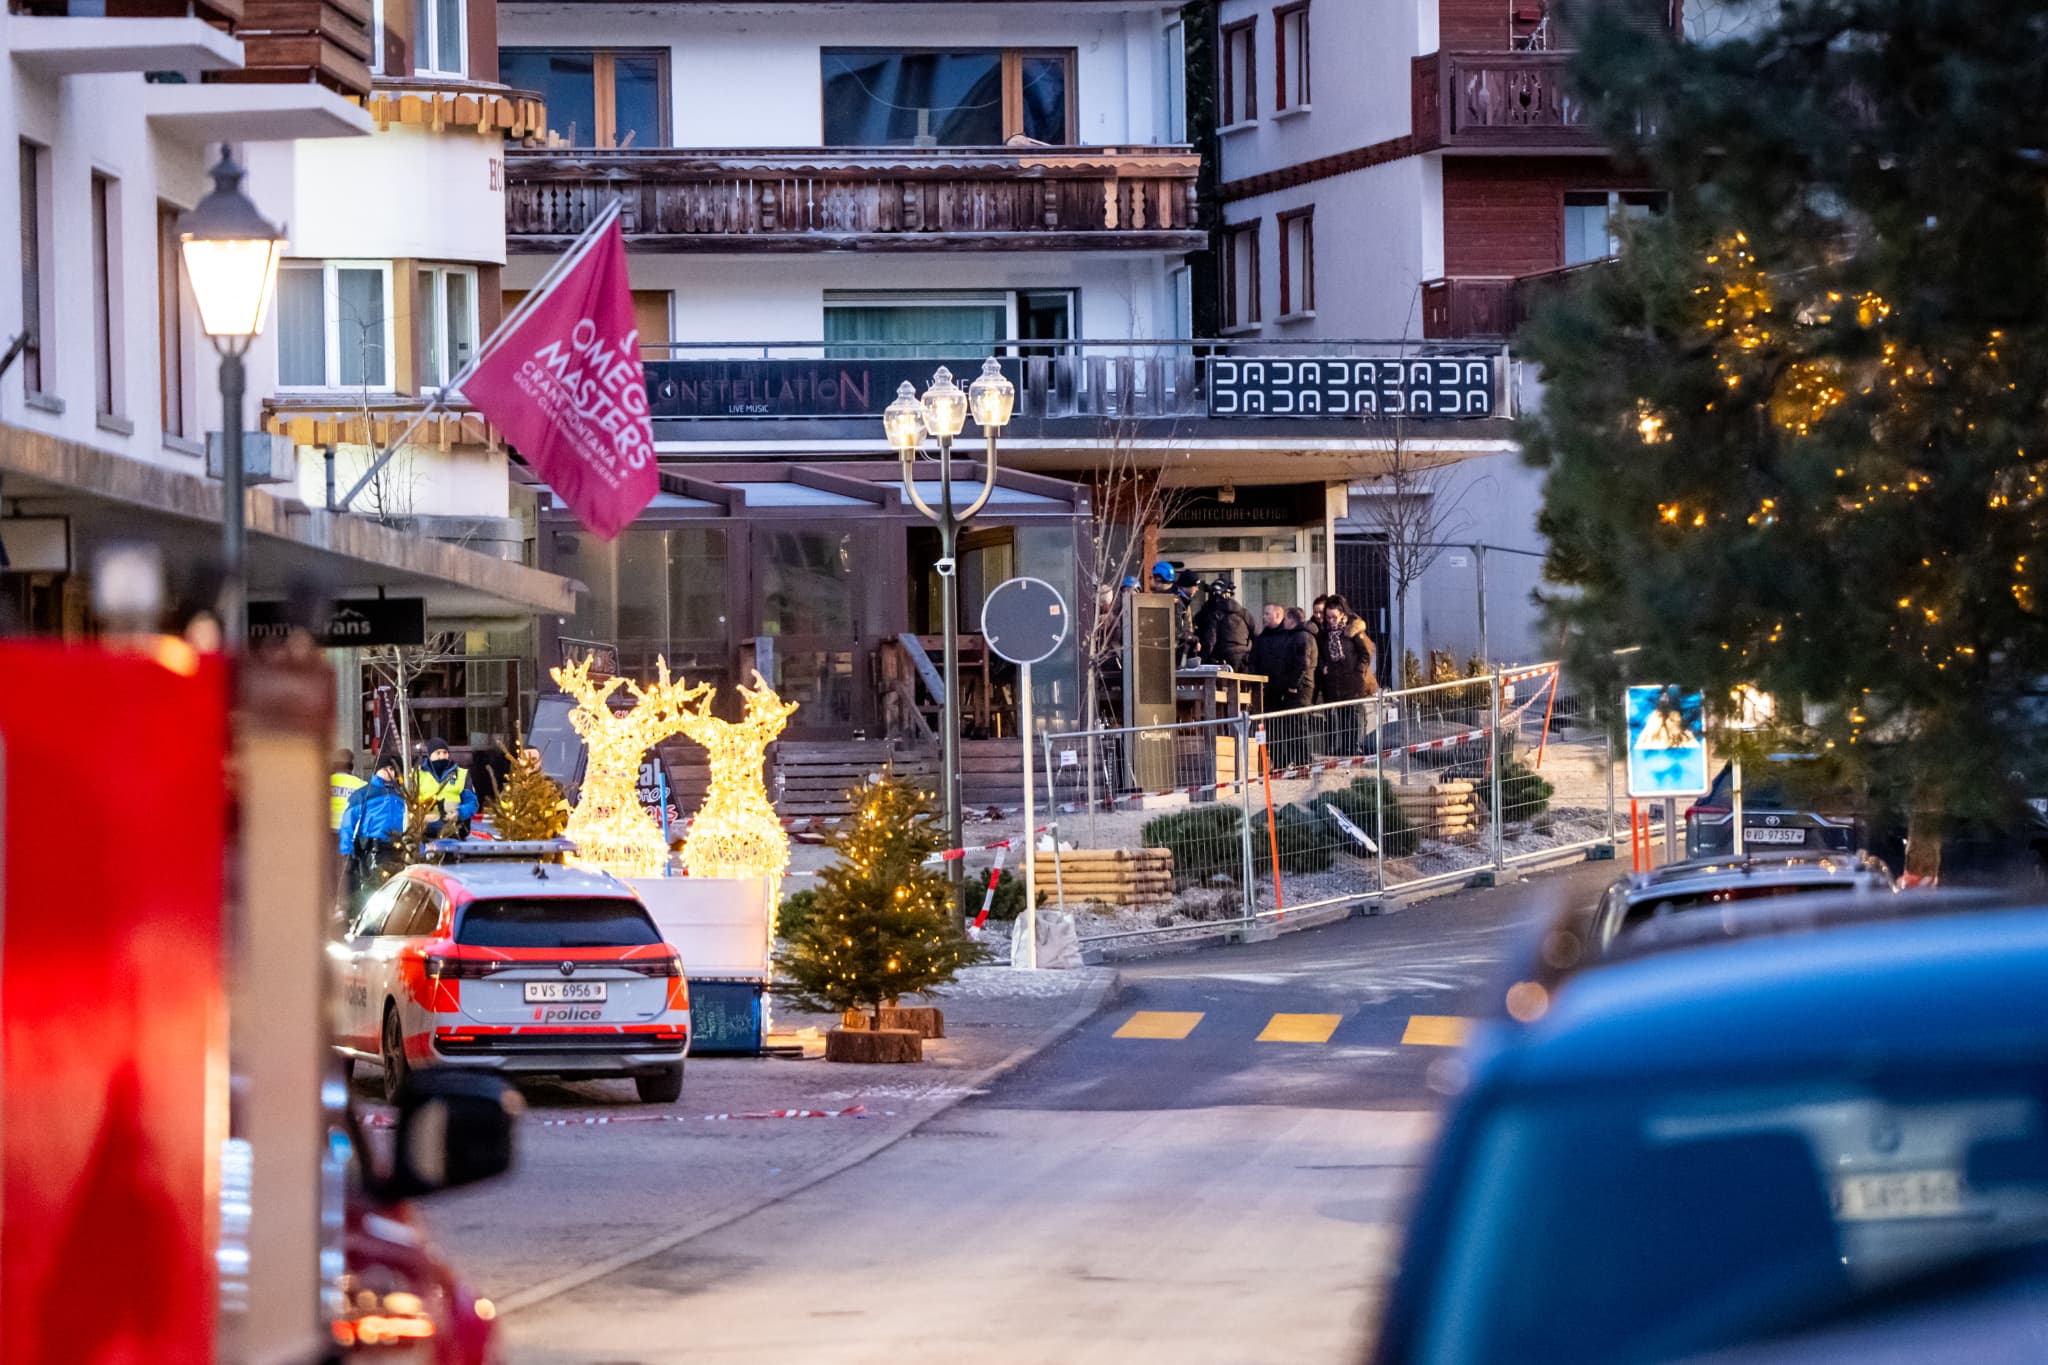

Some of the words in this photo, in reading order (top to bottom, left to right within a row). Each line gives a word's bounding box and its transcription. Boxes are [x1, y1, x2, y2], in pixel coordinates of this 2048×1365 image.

[535, 340, 652, 469] MASTERS
[729, 405, 744, 413] LIVE
[746, 405, 768, 413] MUSIC
[323, 621, 371, 635] rans
[541, 984, 556, 998] VS
[562, 984, 591, 998] 6956
[545, 1007, 602, 1024] police
